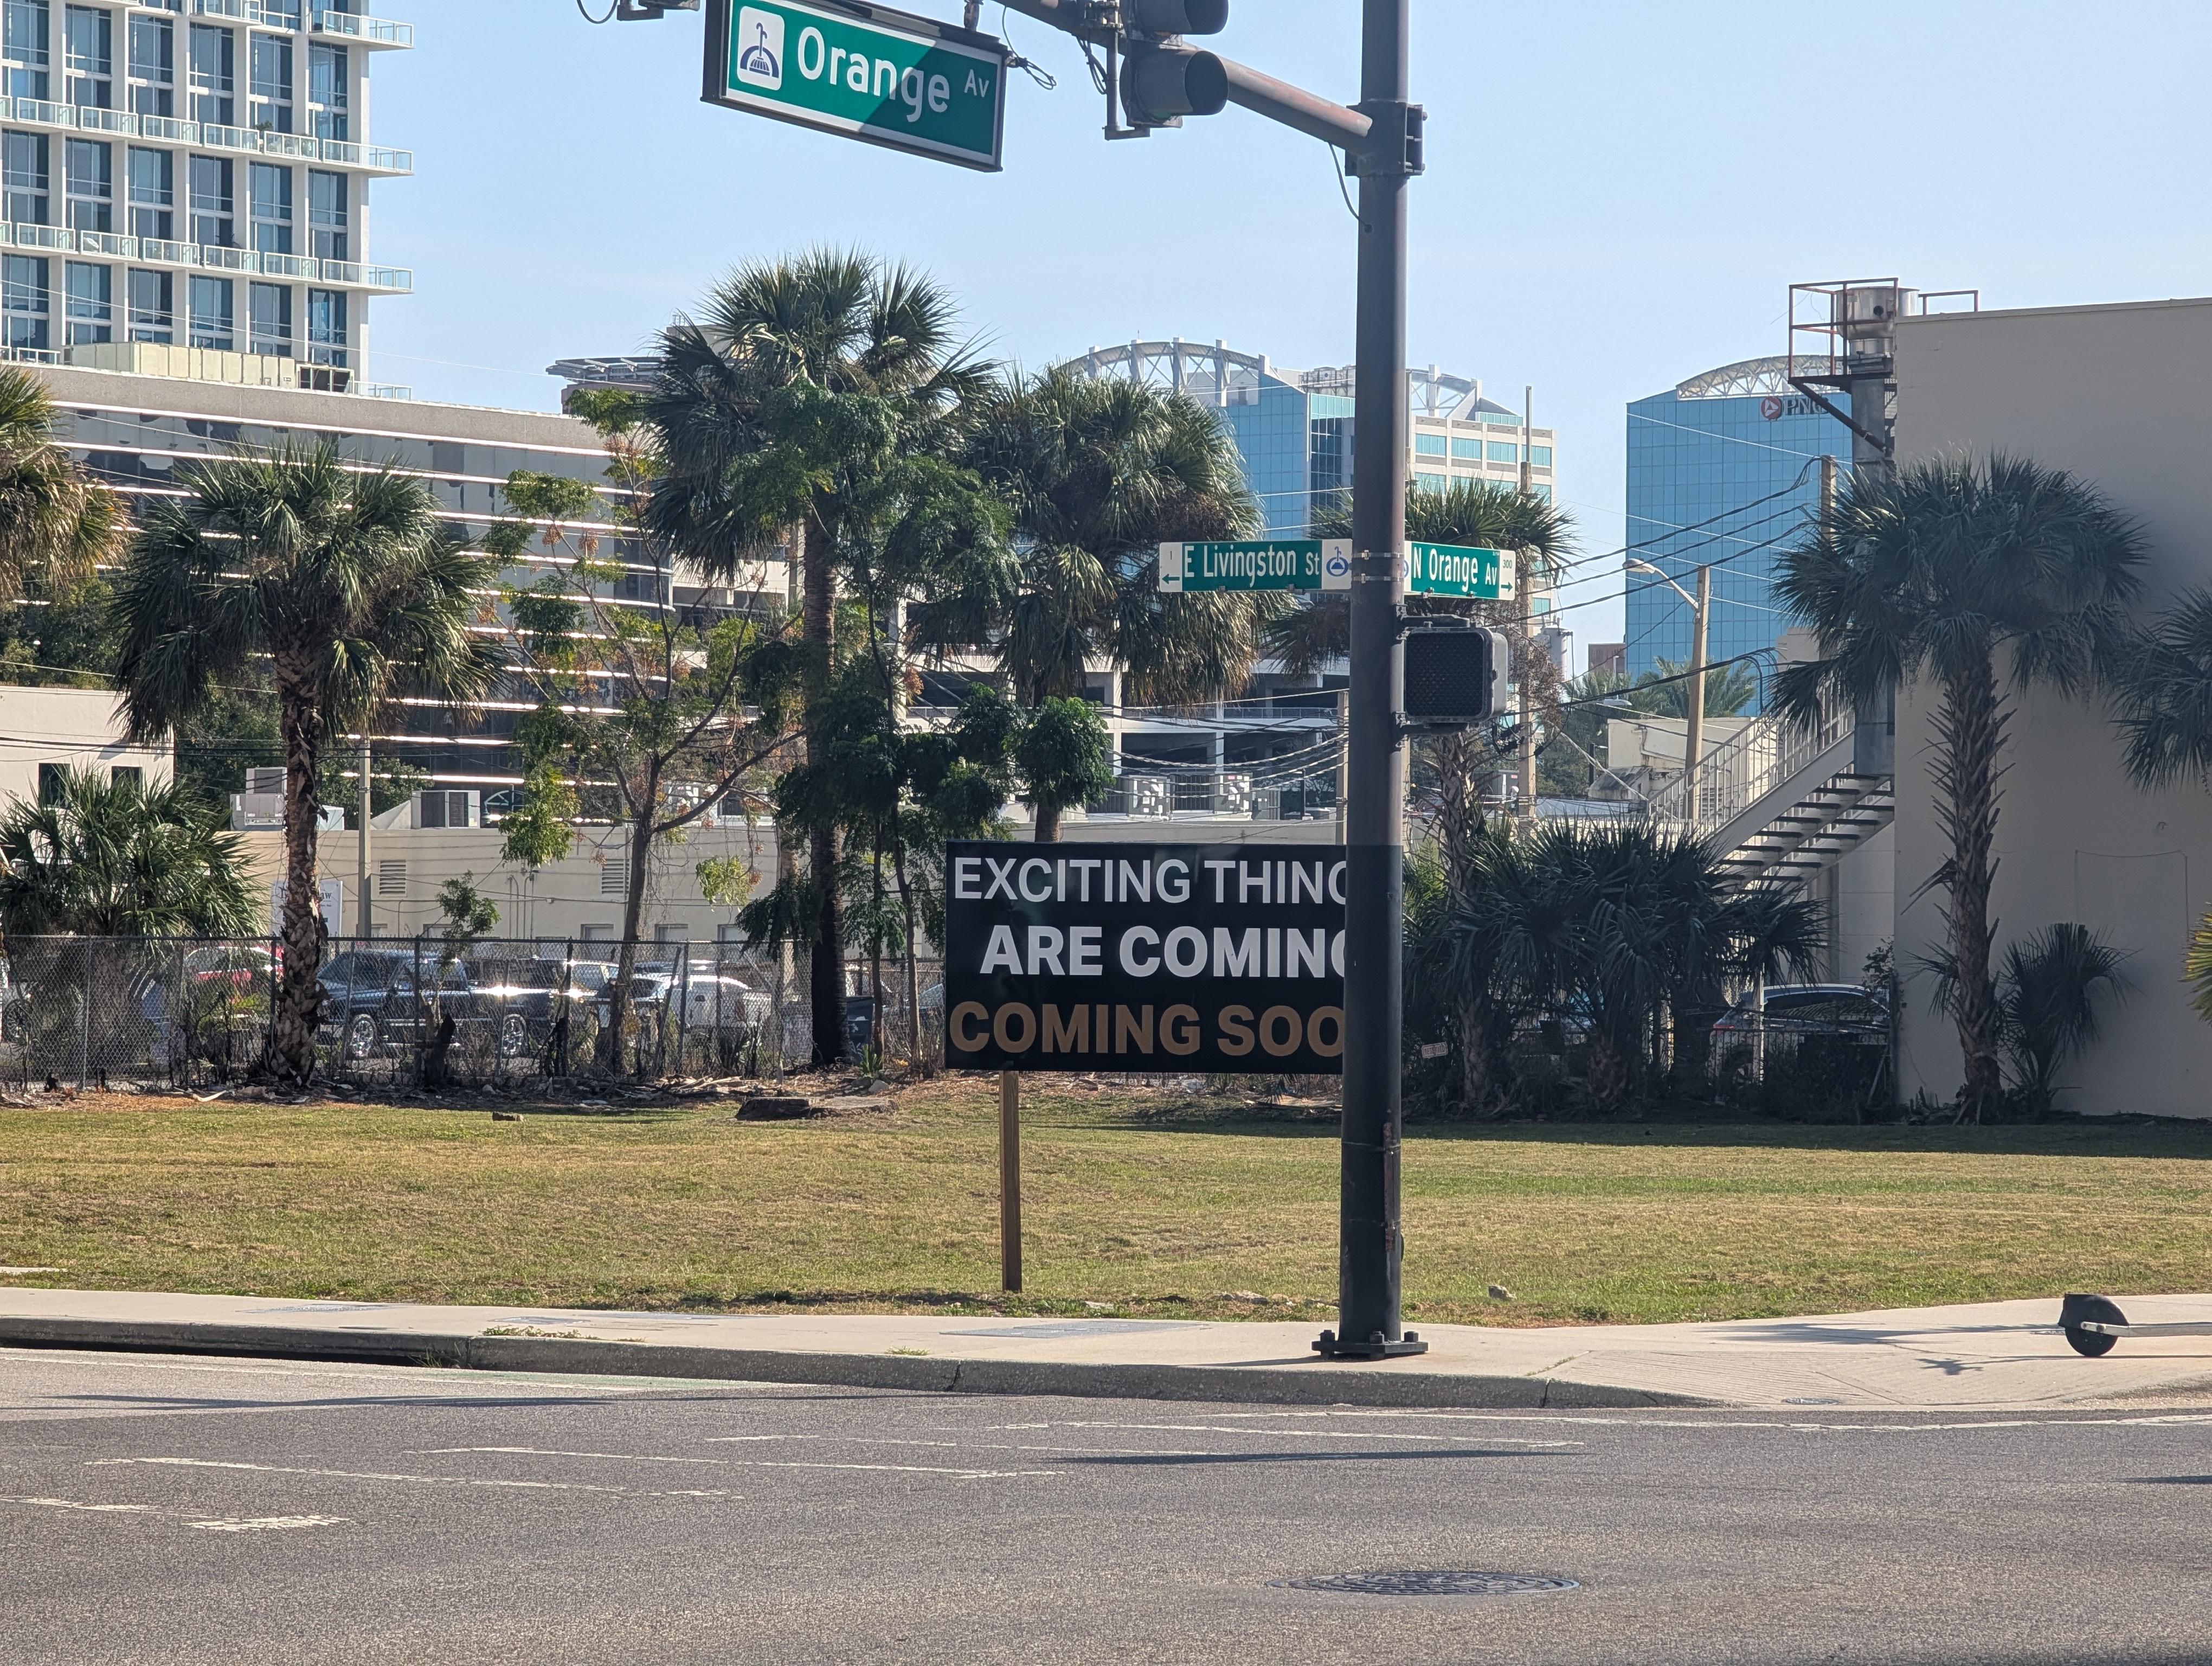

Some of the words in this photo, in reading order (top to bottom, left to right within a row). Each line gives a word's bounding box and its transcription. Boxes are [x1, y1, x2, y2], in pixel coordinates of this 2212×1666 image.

[798, 26, 950, 123] Orange
[964, 69, 989, 97] Av
[1185, 546, 1194, 578] E
[1204, 544, 1296, 588] Livingston
[1306, 552, 1320, 575] St
[1413, 547, 1422, 579] N
[1429, 548, 1478, 592] Orange
[1484, 562, 1497, 586] Av
[1502, 559, 1513, 569] 300
[954, 857, 1190, 903] EXCITING
[979, 925, 1103, 977] ARE
[949, 1001, 1200, 1056] COMING
[1218, 1004, 1345, 1058] SOO
